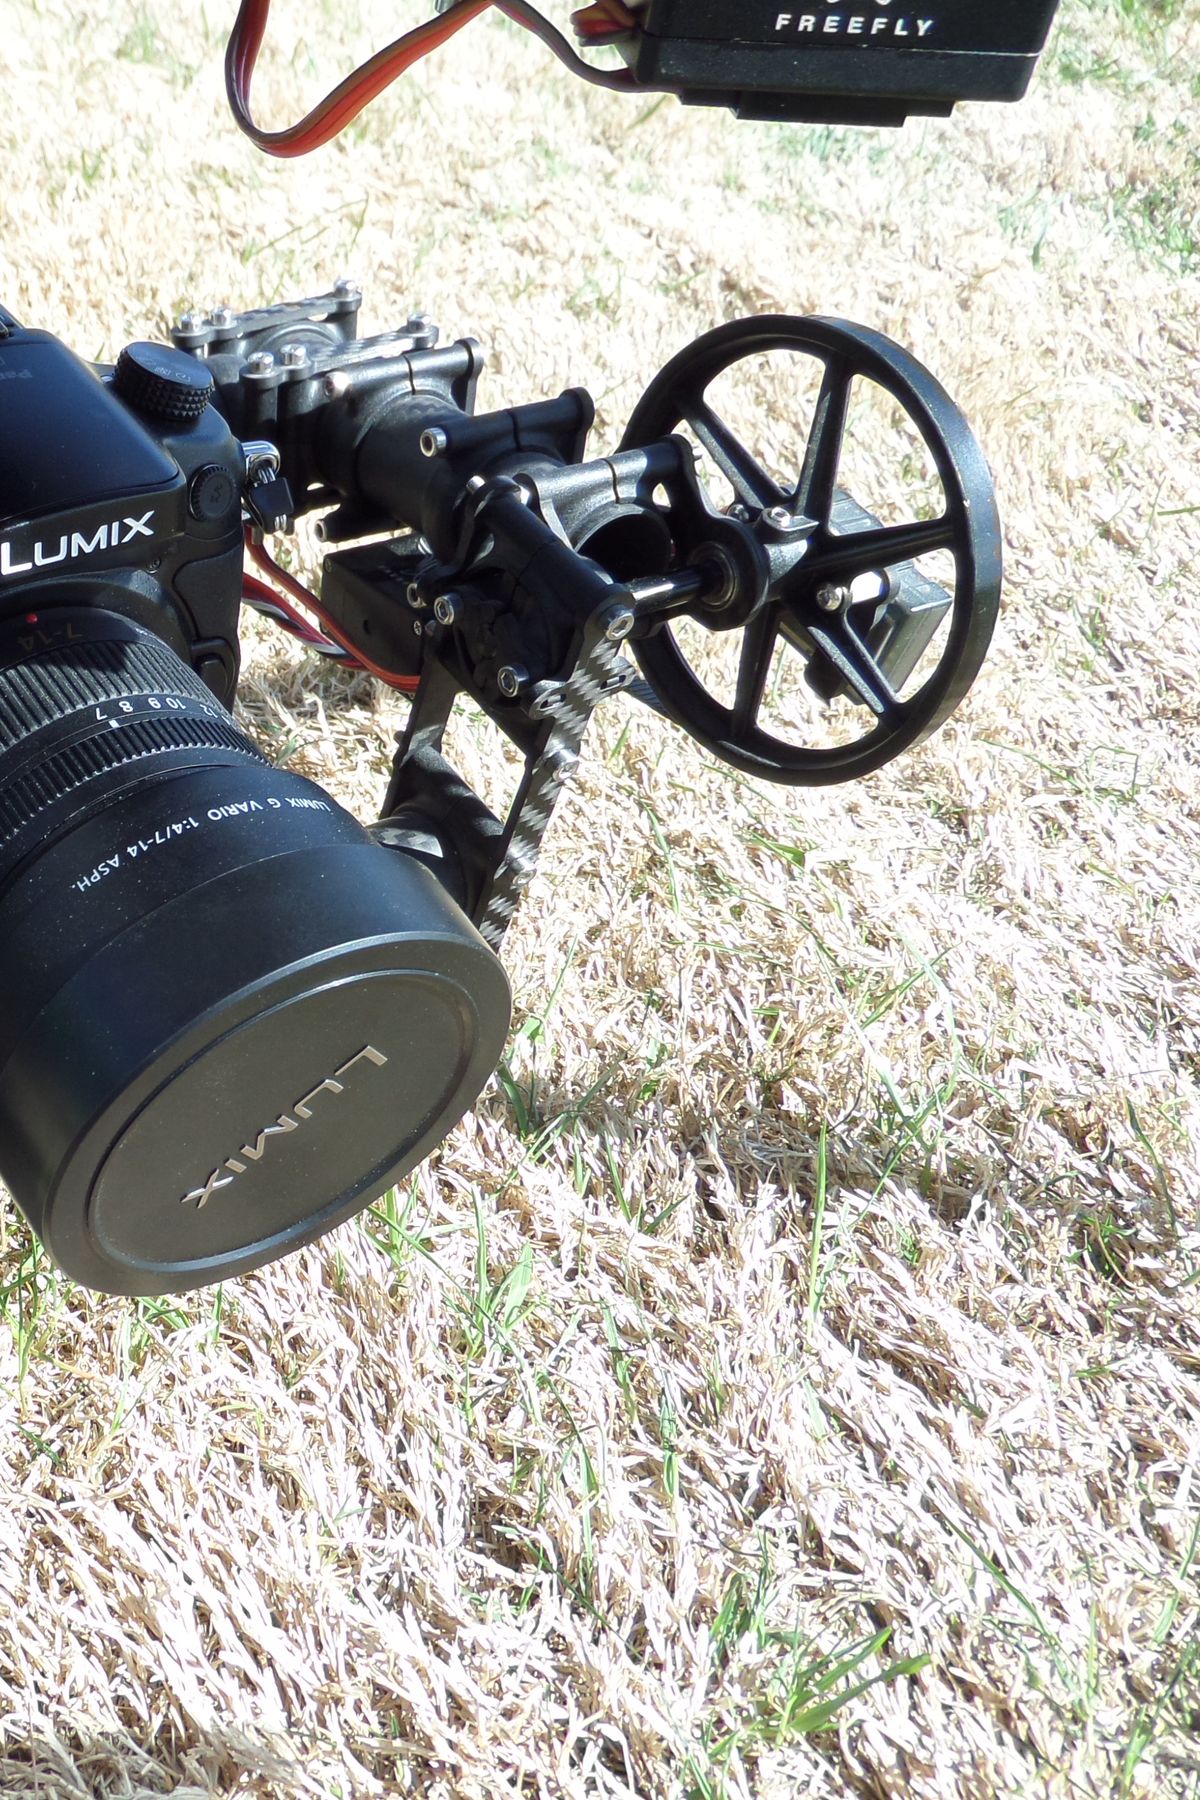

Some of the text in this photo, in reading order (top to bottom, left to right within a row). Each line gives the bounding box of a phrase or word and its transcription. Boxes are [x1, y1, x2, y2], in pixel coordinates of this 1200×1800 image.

[775, 13, 934, 37] FREEFLY
[0, 510, 155, 576] LUMIX
[95, 707, 108, 721] 7
[118, 701, 133, 713] 8
[147, 697, 161, 709] 9
[166, 697, 187, 710] 10
[71, 797, 332, 893] LUMIX G VARIO 1:4/7-14 ASPH.
[180, 1045, 388, 1209] LUMIX
